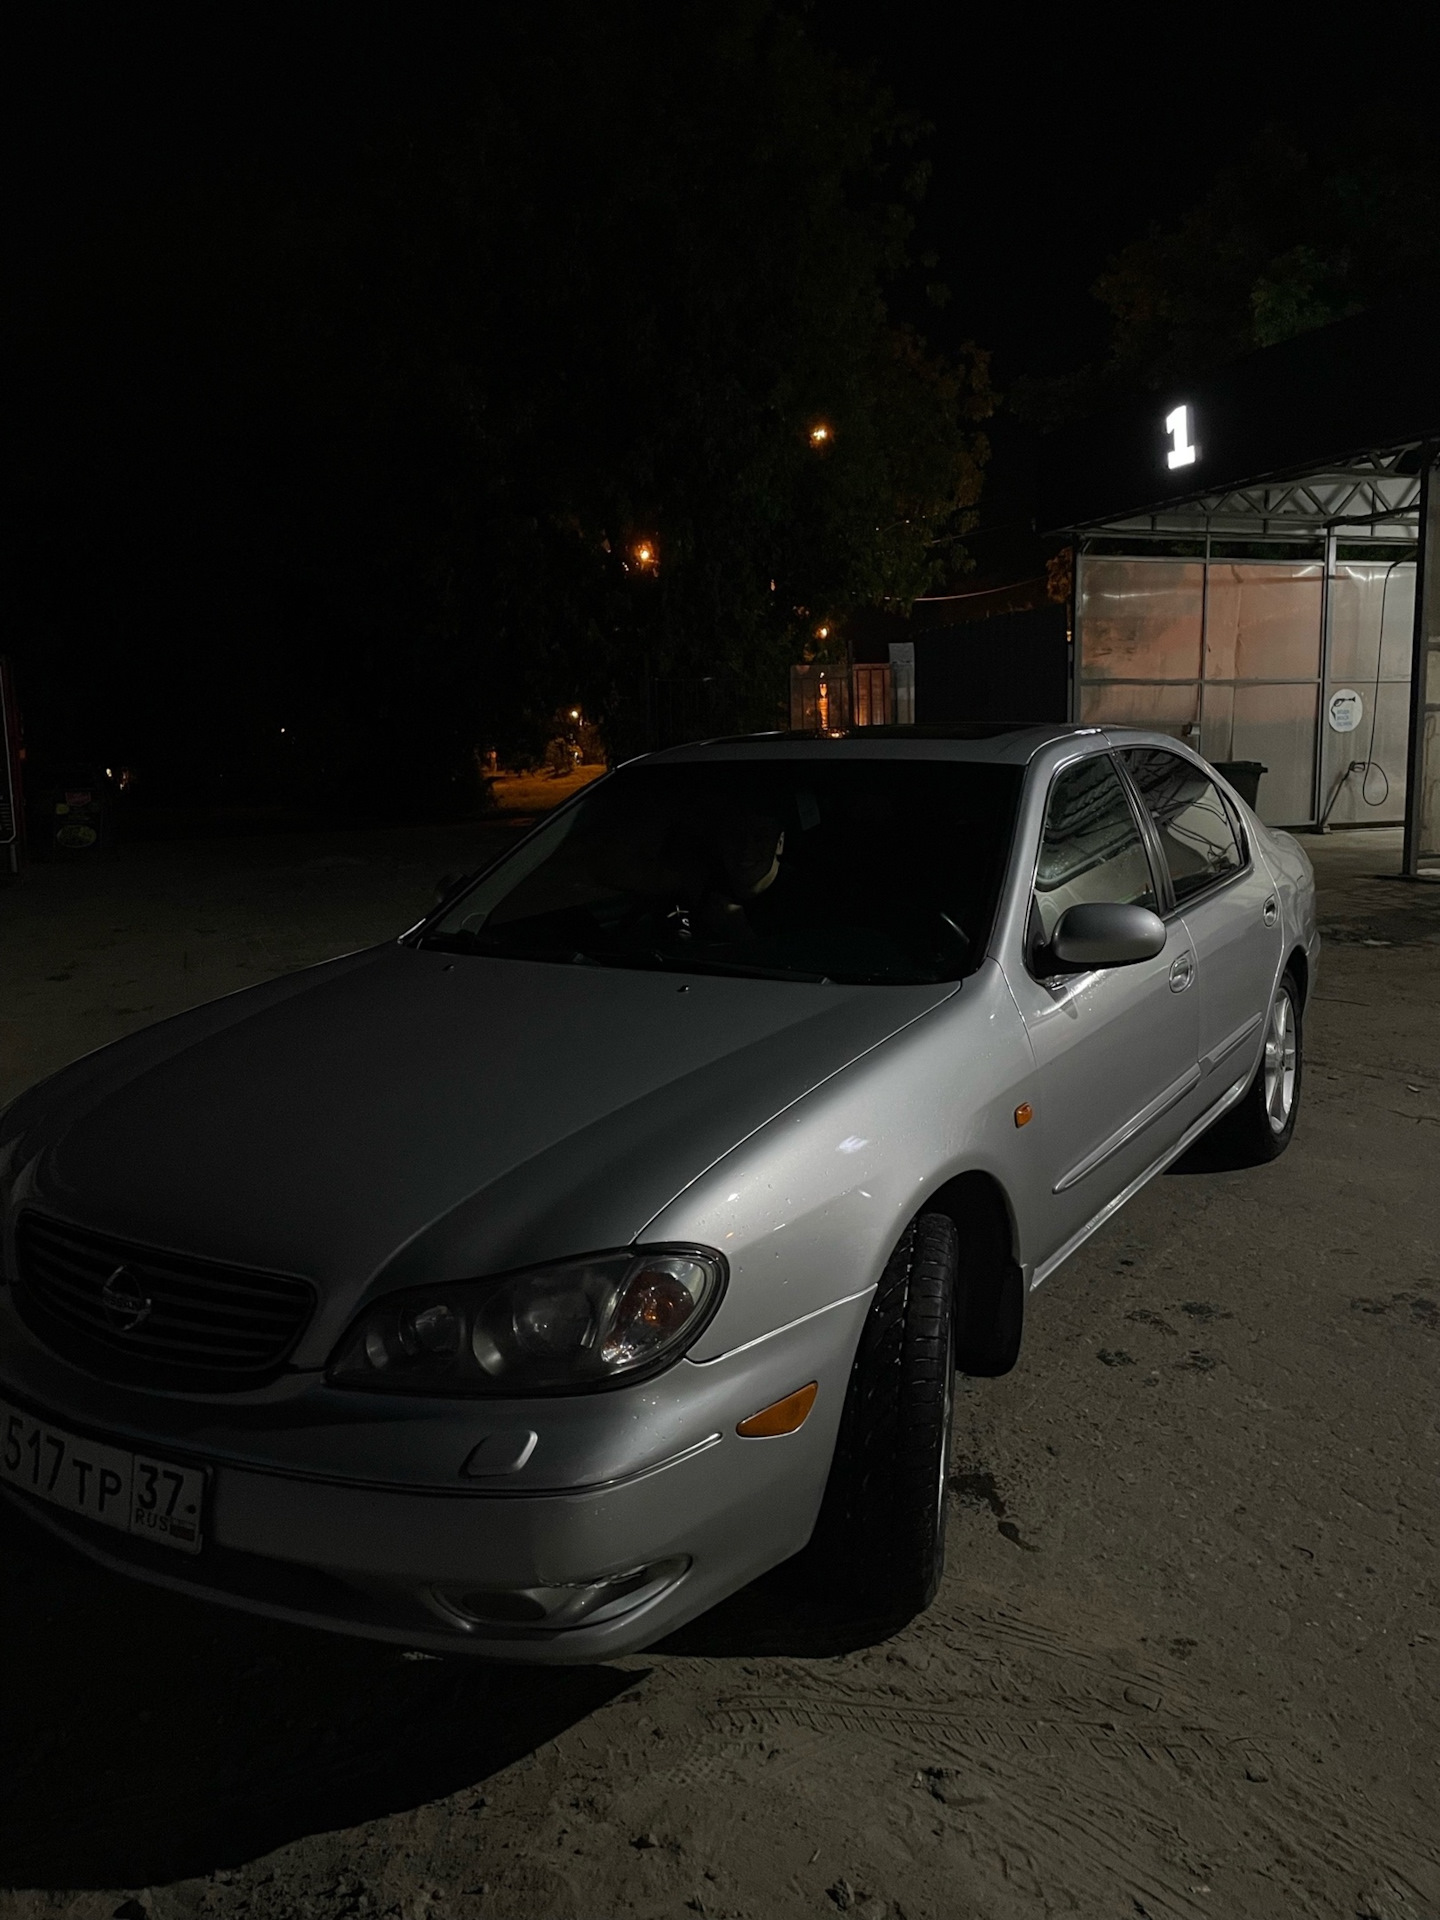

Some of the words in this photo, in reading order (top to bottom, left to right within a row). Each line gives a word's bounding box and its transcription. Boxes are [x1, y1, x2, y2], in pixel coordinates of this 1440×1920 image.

[1165, 404, 1196, 471] 1
[137, 1463, 184, 1517] 37
[134, 1507, 169, 1532] RUS
